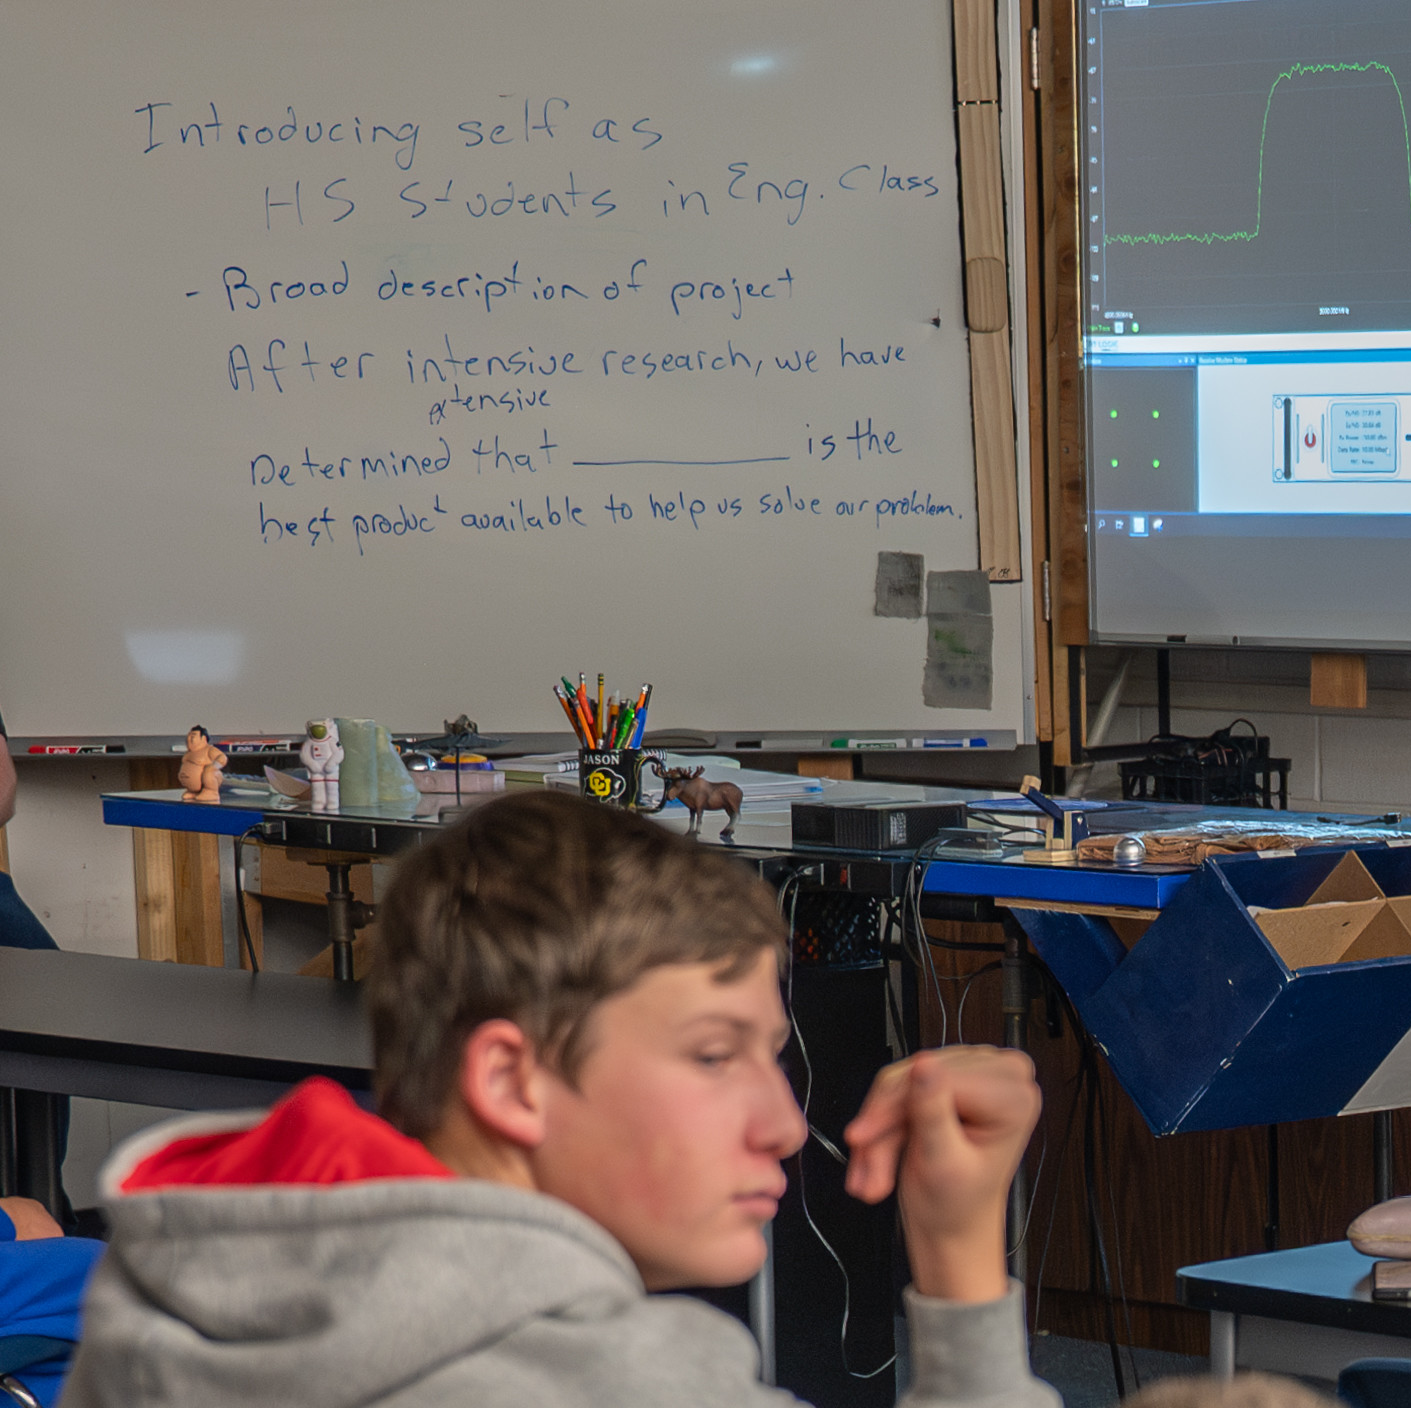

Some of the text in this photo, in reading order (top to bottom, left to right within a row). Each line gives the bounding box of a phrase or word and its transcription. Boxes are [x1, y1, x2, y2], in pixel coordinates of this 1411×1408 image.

[134, 96, 663, 171] Introducing self as
[265, 161, 939, 230] HS Students in Eng. Class
[222, 258, 794, 321] Broad description of project
[228, 333, 906, 394] After intensive research, we have
[250, 417, 903, 487] Determined that is the
[259, 484, 963, 557] best product available to help us solve our problem.
[583, 754, 620, 765] JASON
